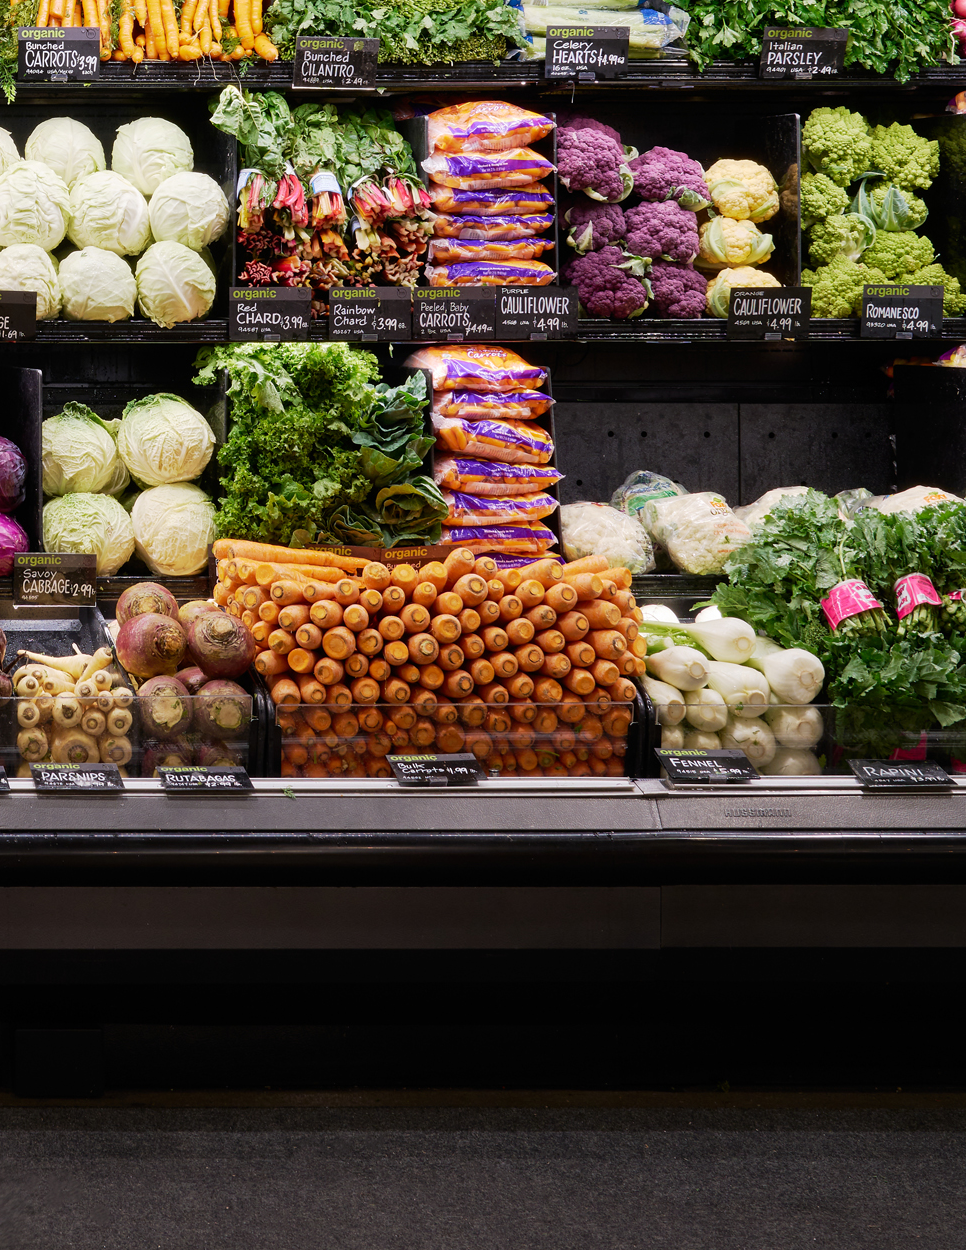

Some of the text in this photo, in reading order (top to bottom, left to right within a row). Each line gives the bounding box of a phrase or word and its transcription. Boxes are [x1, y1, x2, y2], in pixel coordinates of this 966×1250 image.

[21, 28, 65, 40] organic
[549, 27, 594, 38] organic
[768, 28, 812, 39] organic
[26, 42, 64, 50] Bunched
[300, 39, 344, 50] organic
[553, 40, 593, 52] Celery
[769, 42, 803, 50] Italian
[25, 50, 97, 72] CARROTS $3.99
[304, 51, 350, 62] Bunched
[553, 50, 597, 64] HEARTS
[597, 48, 618, 67] $4.99
[767, 52, 822, 65] PARSLEY
[301, 61, 354, 77] CILANTRO
[808, 66, 832, 74] $2.49
[233, 288, 276, 300] organic
[332, 287, 376, 300] organic
[417, 287, 460, 299] organic
[867, 286, 910, 297] organic
[237, 303, 257, 312] Red
[334, 304, 375, 315] Rainbow
[450, 302, 469, 312] Baby
[501, 296, 569, 315] CAULIFLOWER
[734, 298, 802, 316] CAULIFLOWER
[866, 303, 919, 319] ROMANESCO
[237, 313, 302, 330] CHARD $3.99
[334, 316, 367, 326] Chard
[371, 316, 397, 331] $3.99
[420, 312, 487, 336] CARROTS $4.49
[533, 316, 559, 331] $4.99
[766, 317, 792, 331] $4.99
[902, 320, 928, 332] $4.99
[467, 351, 507, 359] Carrots
[385, 547, 427, 559] organic
[18, 555, 61, 566] organic
[23, 569, 57, 581] Savoy
[23, 579, 91, 598] CABBAGE $2.99
[669, 758, 722, 767] FENNEL
[41, 771, 105, 781] PARSNIPS
[166, 773, 236, 782] RUTABAGAS
[862, 766, 924, 777] RAPINI
